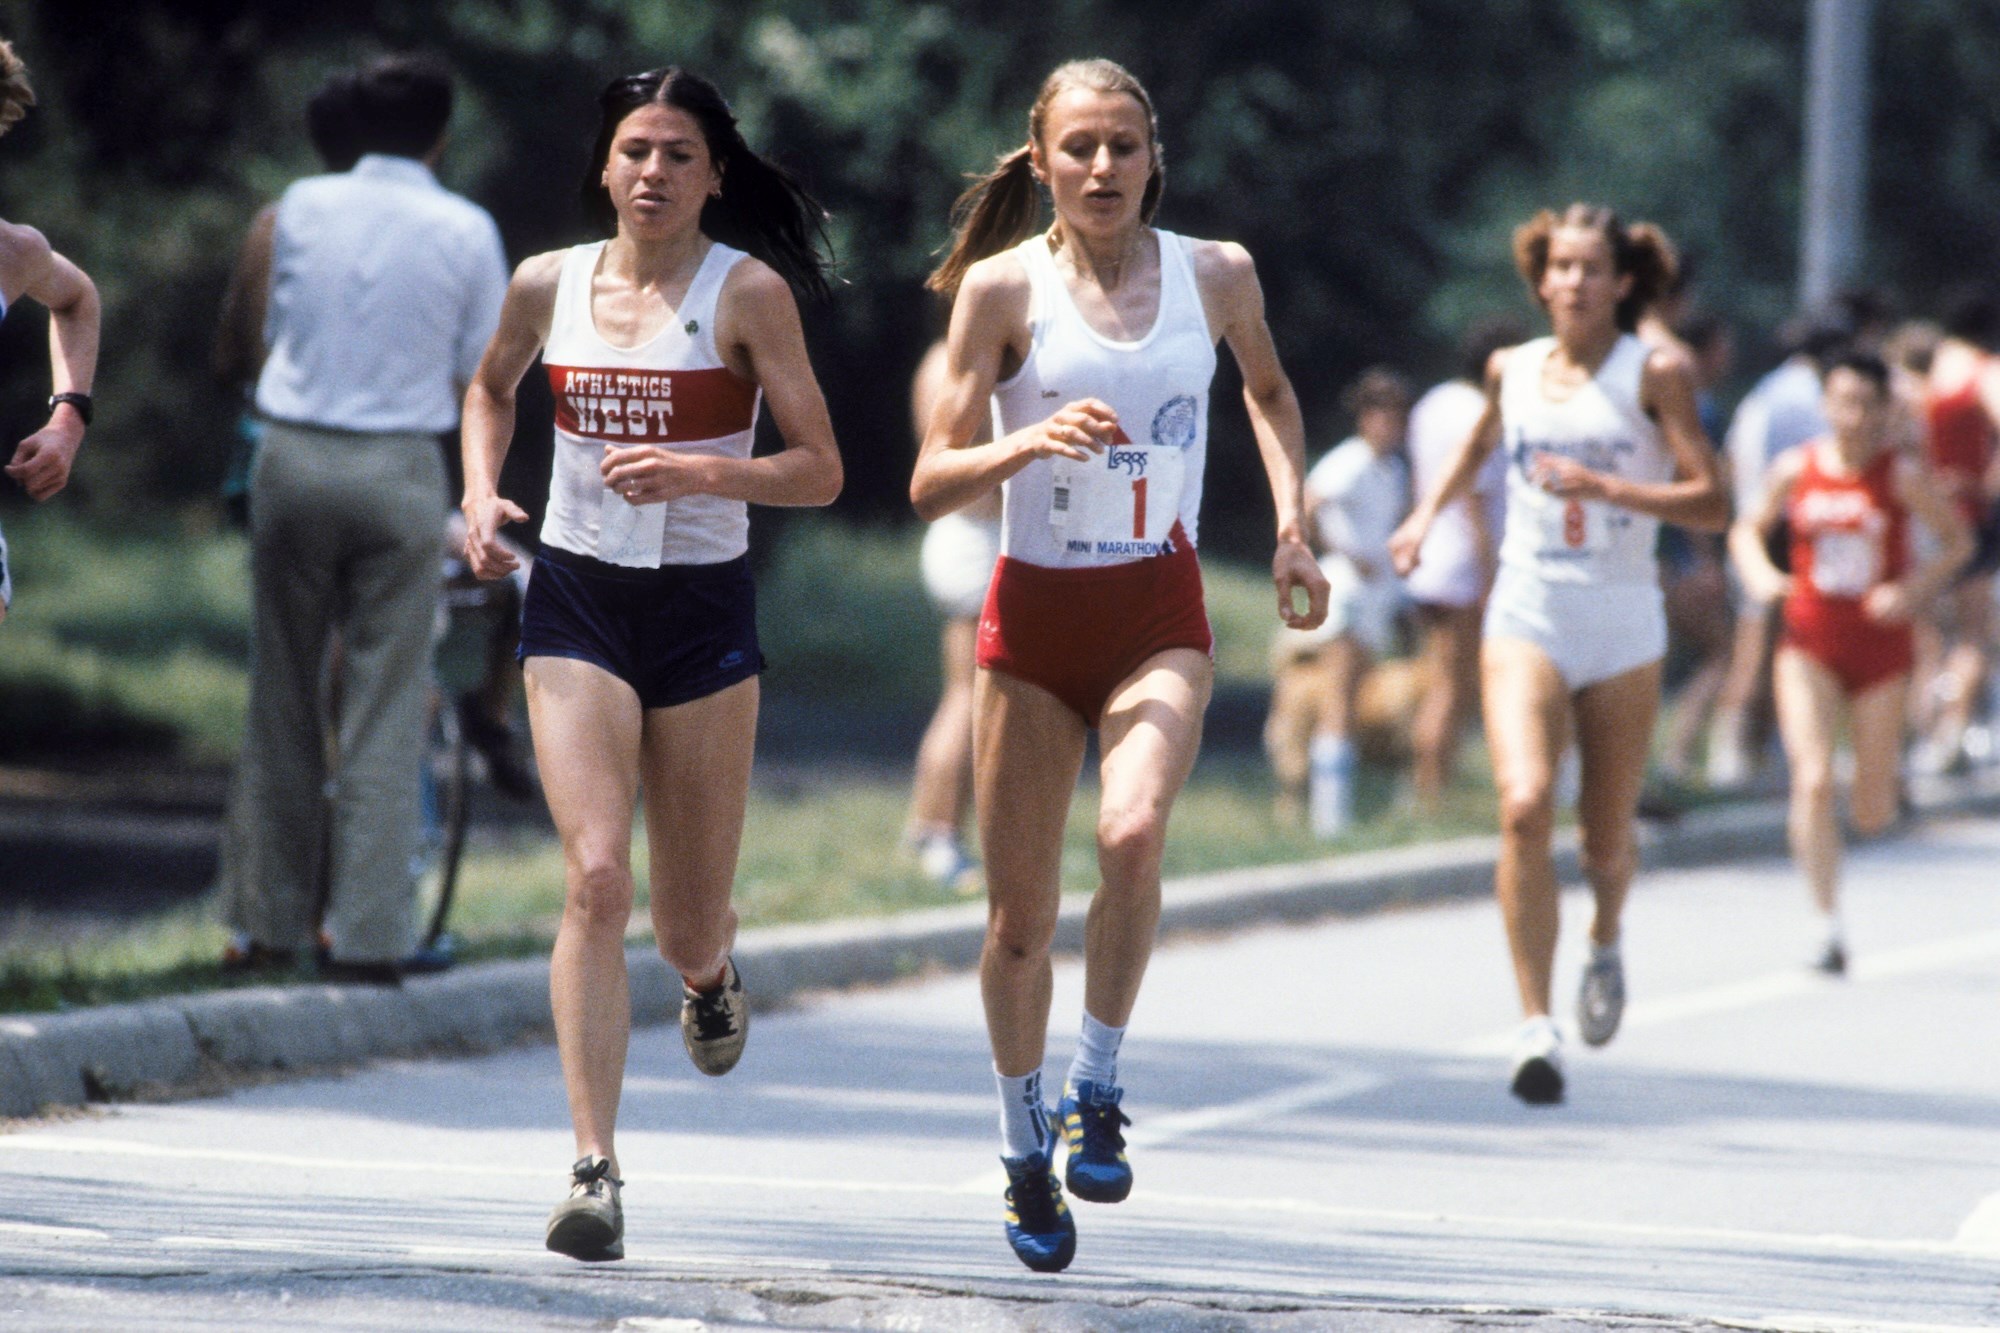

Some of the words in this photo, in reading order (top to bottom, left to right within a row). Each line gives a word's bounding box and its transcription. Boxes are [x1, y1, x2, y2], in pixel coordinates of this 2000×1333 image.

[565, 371, 672, 398] ATHLETICS
[567, 396, 673, 436] WEST
[1132, 477, 1148, 540] 1
[1067, 540, 1091, 554] MINI
[1097, 541, 1161, 556] MARATHON
